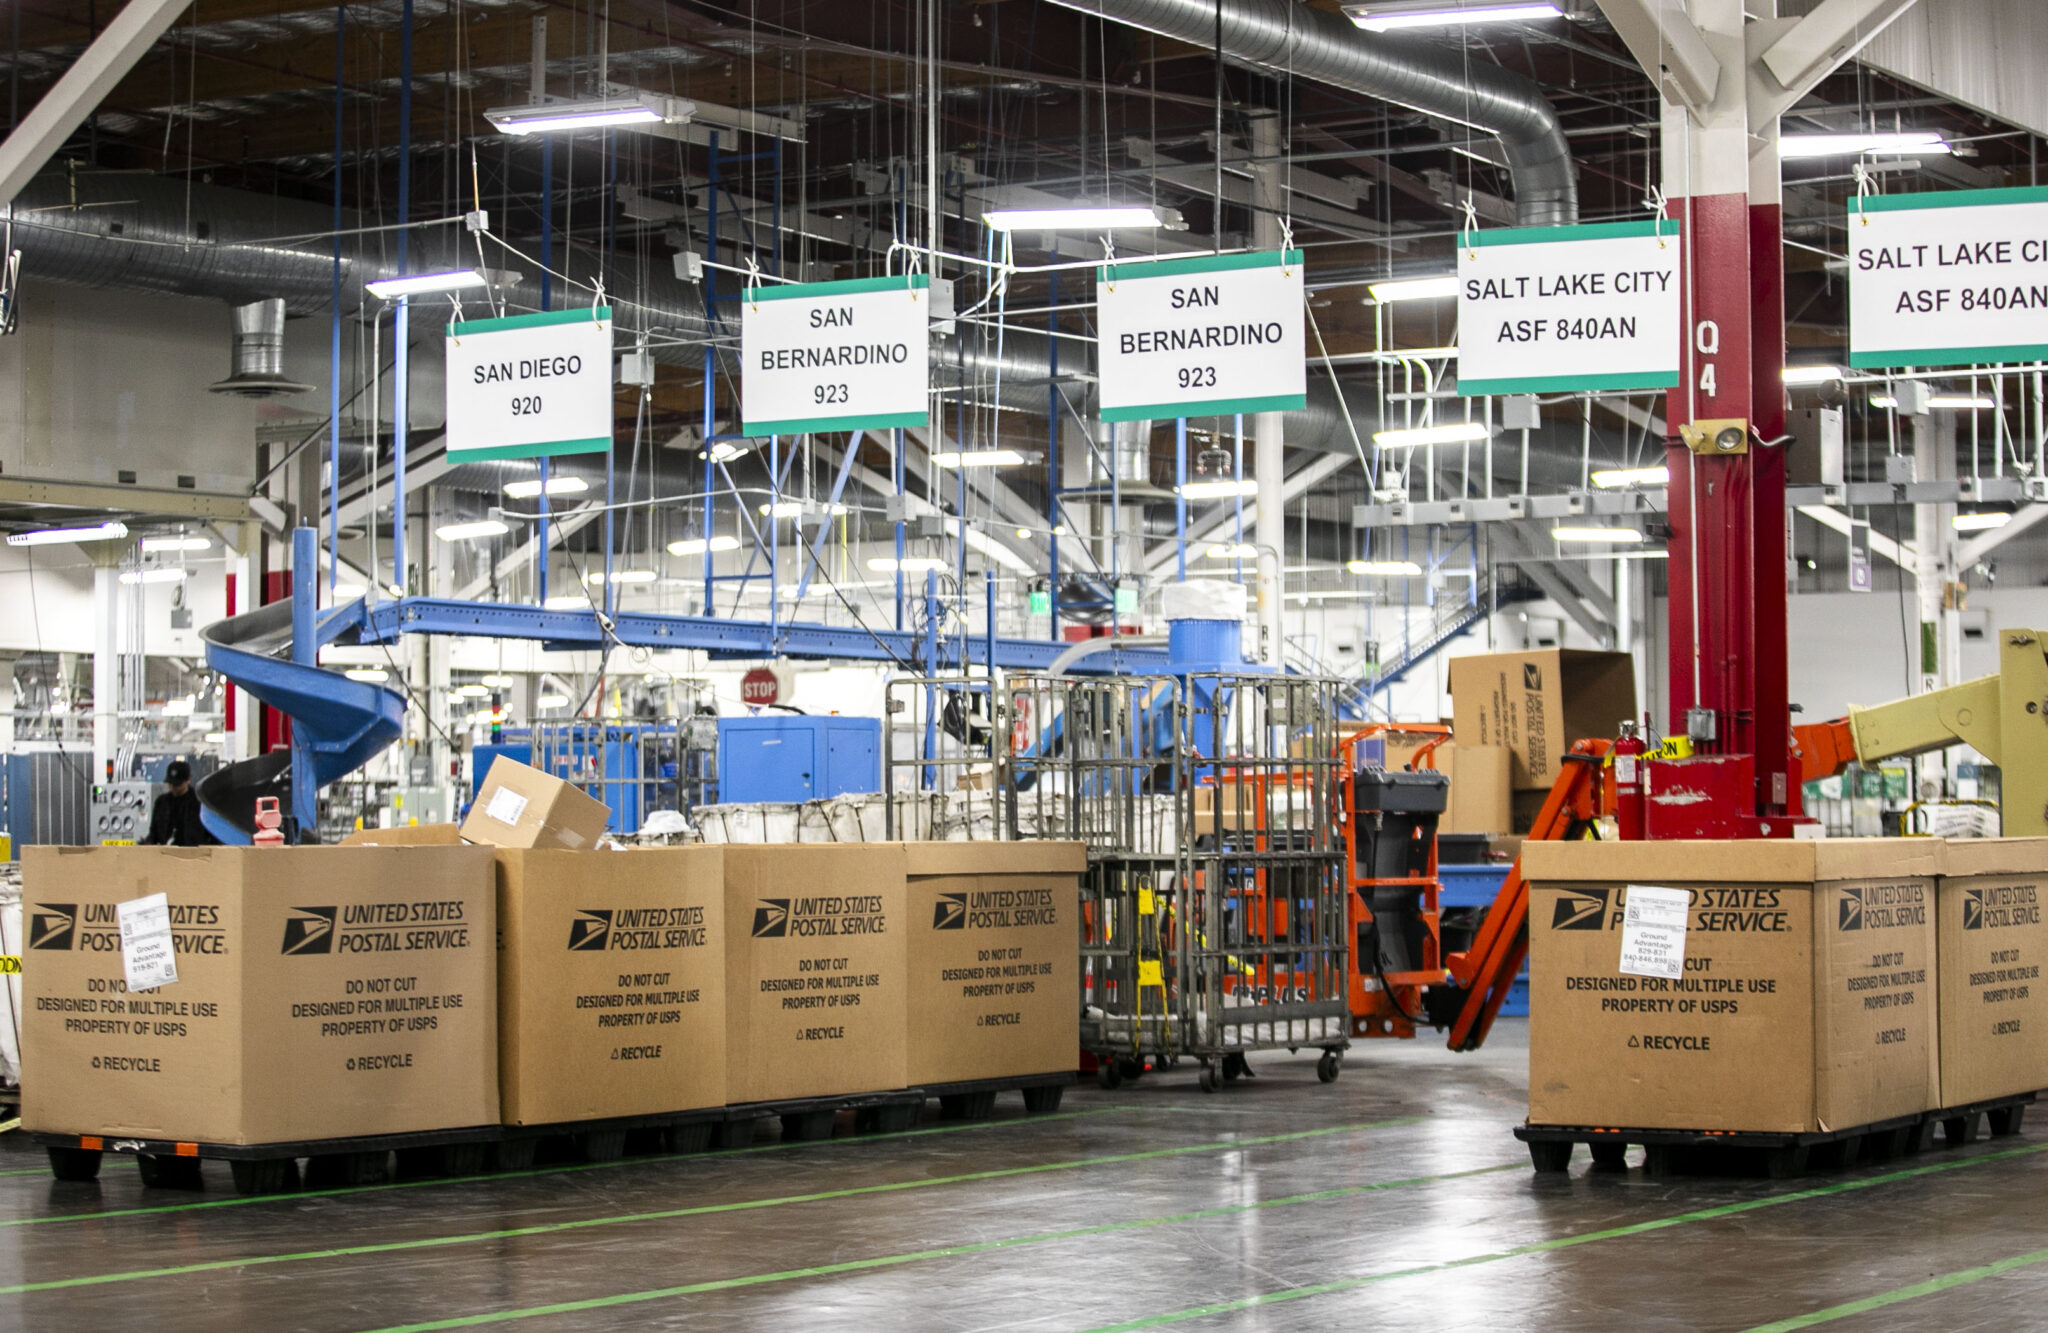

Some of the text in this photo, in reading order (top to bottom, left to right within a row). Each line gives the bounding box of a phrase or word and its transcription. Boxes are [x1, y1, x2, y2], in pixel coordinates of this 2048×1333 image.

[1858, 246, 1928, 270] SALT
[1938, 241, 2012, 266] LAKE
[1465, 270, 1672, 301] SALT LAKE CITY
[1171, 285, 1220, 310] SAN
[1896, 286, 2048, 313] ASF 840AN
[810, 307, 854, 329] SAN
[1120, 322, 1283, 355] BERNARDINO
[1497, 315, 1637, 343] ASF 840AN
[1696, 320, 1719, 355] Q
[761, 343, 908, 370] BERNARDINO
[474, 355, 582, 384] SAN DIEGO
[1178, 365, 1218, 389] 923
[1699, 363, 1717, 397] 4
[814, 384, 849, 404] 923
[511, 397, 542, 416] 920
[744, 682, 776, 698] STOP
[970, 889, 1052, 909] UNITED STATES
[1702, 889, 1781, 908] STATES
[1865, 884, 1924, 906] UNITED STATES
[1984, 886, 2037, 907] UNITED STATES
[84, 904, 117, 923] UNI
[169, 905, 219, 924] TATES
[343, 901, 464, 924] UNITED STATES
[794, 896, 882, 915] UNITED STATES
[616, 906, 704, 928] UNITED STATES
[790, 916, 885, 937] POSTAL SERVICE
[969, 908, 1056, 928] POSTAL SERVICE
[1698, 912, 1787, 932] SERVICE
[1864, 906, 1926, 929] POSTAL SERVICE
[80, 933, 225, 954] POST RVICE
[338, 929, 468, 953] POSTAL SERVICE
[610, 928, 706, 950] POSTAL SERVICE
[1634, 938, 1673, 949] Advantage
[1640, 931, 1667, 941] Ground
[978, 948, 1022, 961] DO NOT CUT
[1872, 952, 1904, 967] DO NOT CUT
[799, 958, 848, 972] DO NOT CUT
[942, 963, 1052, 981] DESIGNED FOR MULTIPLE USE
[1684, 958, 1712, 972] CUT
[88, 978, 105, 992] DO
[109, 980, 127, 994] NO
[346, 977, 417, 994] DO NOT CUT
[618, 973, 670, 987] DO NOT CUT
[761, 974, 879, 992] DESIGNED FOR MULTIPLE USE
[1566, 977, 1776, 993] DESIGNED FOR MULTIPLE USE
[1848, 969, 1925, 991] DESIGNED FOR MULTIPLE USE
[576, 989, 700, 1008] DESIGNED FOR MULTIPLE USE
[963, 982, 1035, 998] PROPERTY OF USPS
[37, 997, 218, 1017] DESIGNED FOR MULTIPLE USE
[292, 994, 463, 1018] DESIGNED FOR MULTIPLE USE
[782, 994, 860, 1010] PROPERTY OF USPS
[1602, 998, 1738, 1014] PROPERTY OF USPS
[1864, 992, 1914, 1010] PROPERTY OF USPS
[66, 1018, 187, 1036] PROPERTY OF USPS
[322, 1016, 437, 1036] PROPERTY OF USPS
[598, 1010, 681, 1027] PROPERTY OF USPS
[985, 1013, 1021, 1026] RECYCLE
[806, 1026, 844, 1040] RECYCLE
[1881, 1028, 1906, 1045] RECYCLE
[621, 1045, 662, 1060] RECYCLE
[1643, 1036, 1710, 1050] RECYCLE
[104, 1056, 160, 1072] RECYCLE
[358, 1054, 413, 1070] RECYCLE
